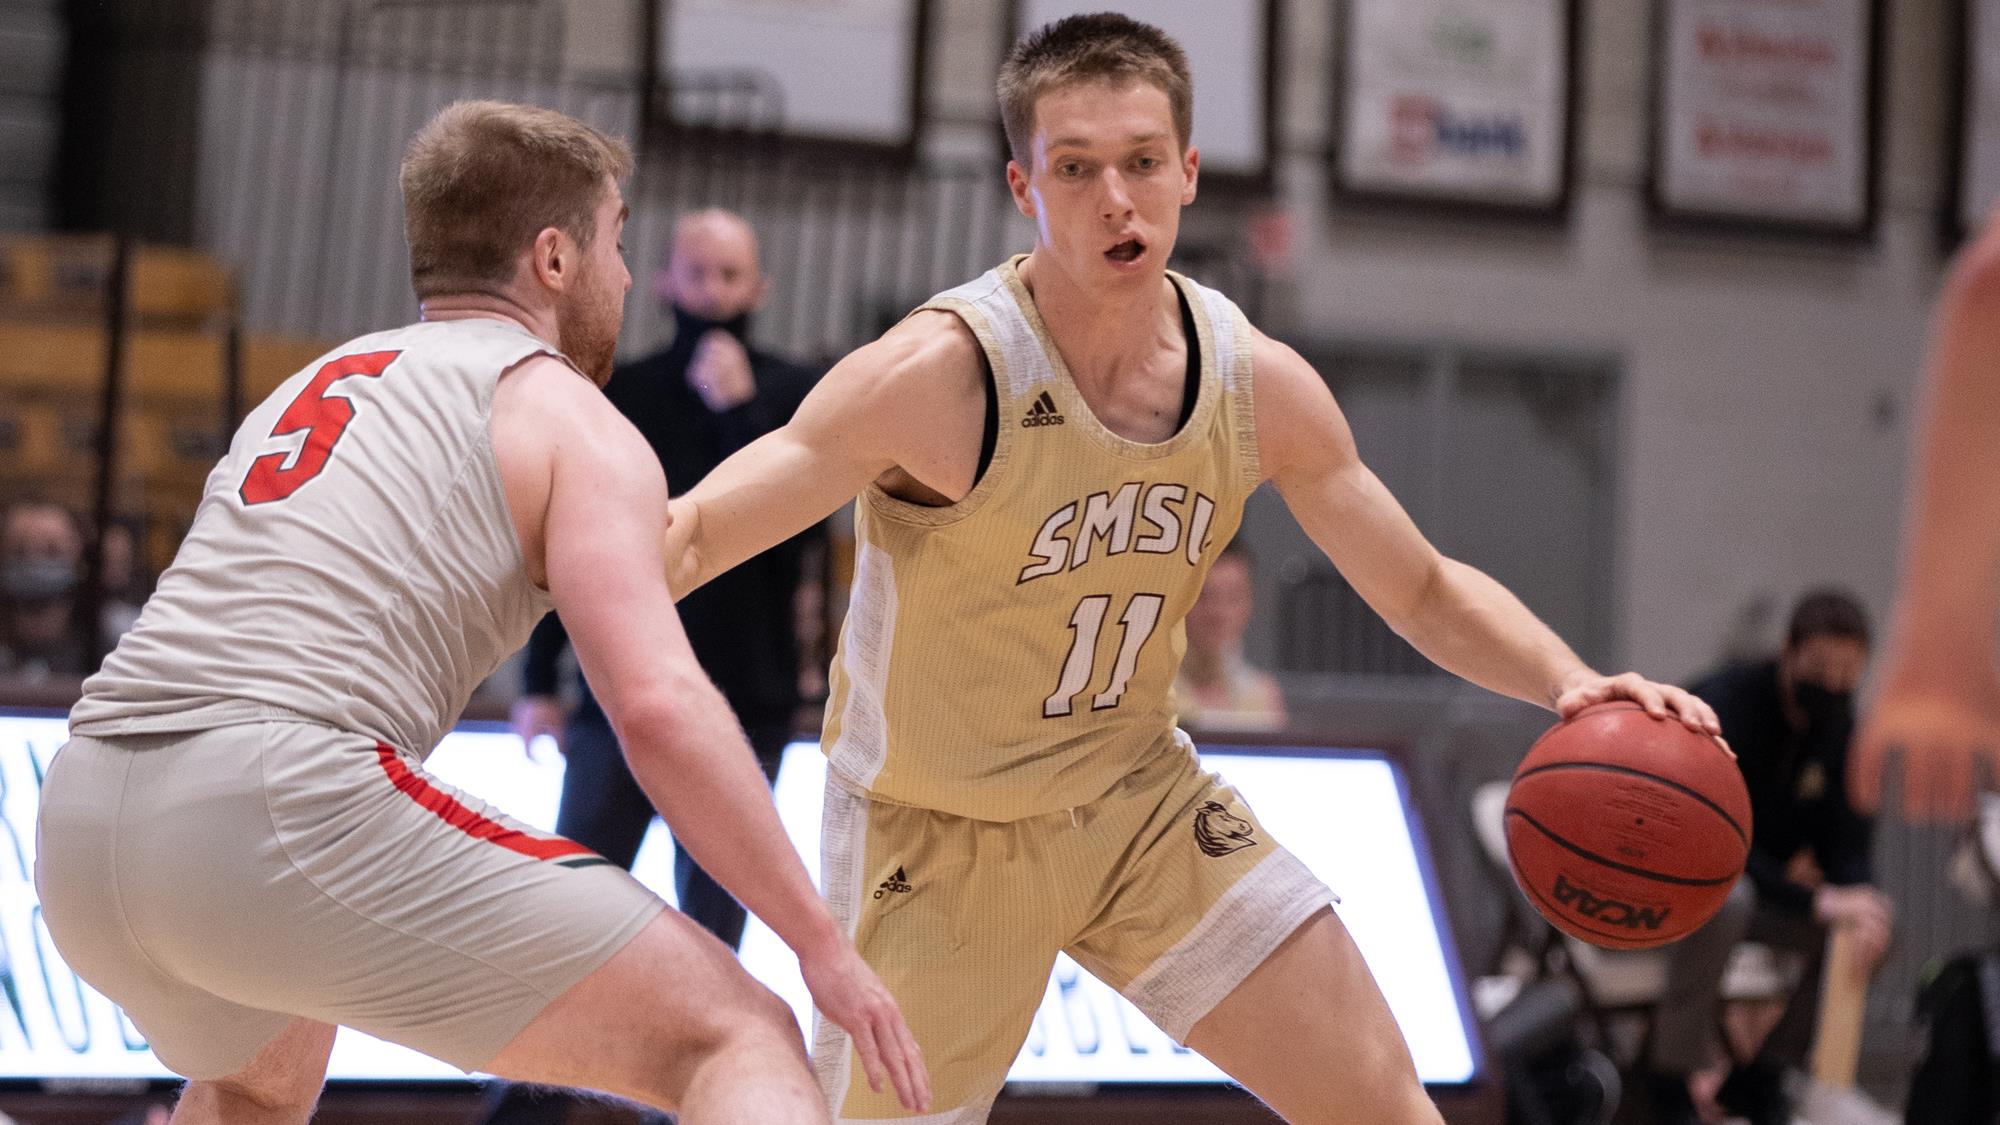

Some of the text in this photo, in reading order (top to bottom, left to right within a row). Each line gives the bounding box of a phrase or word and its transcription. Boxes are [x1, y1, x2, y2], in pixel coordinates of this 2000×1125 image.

[238, 349, 404, 507] 5
[1021, 413, 1065, 428] adidas
[1042, 592, 1166, 719] 11
[1552, 874, 1673, 930] NCAA
